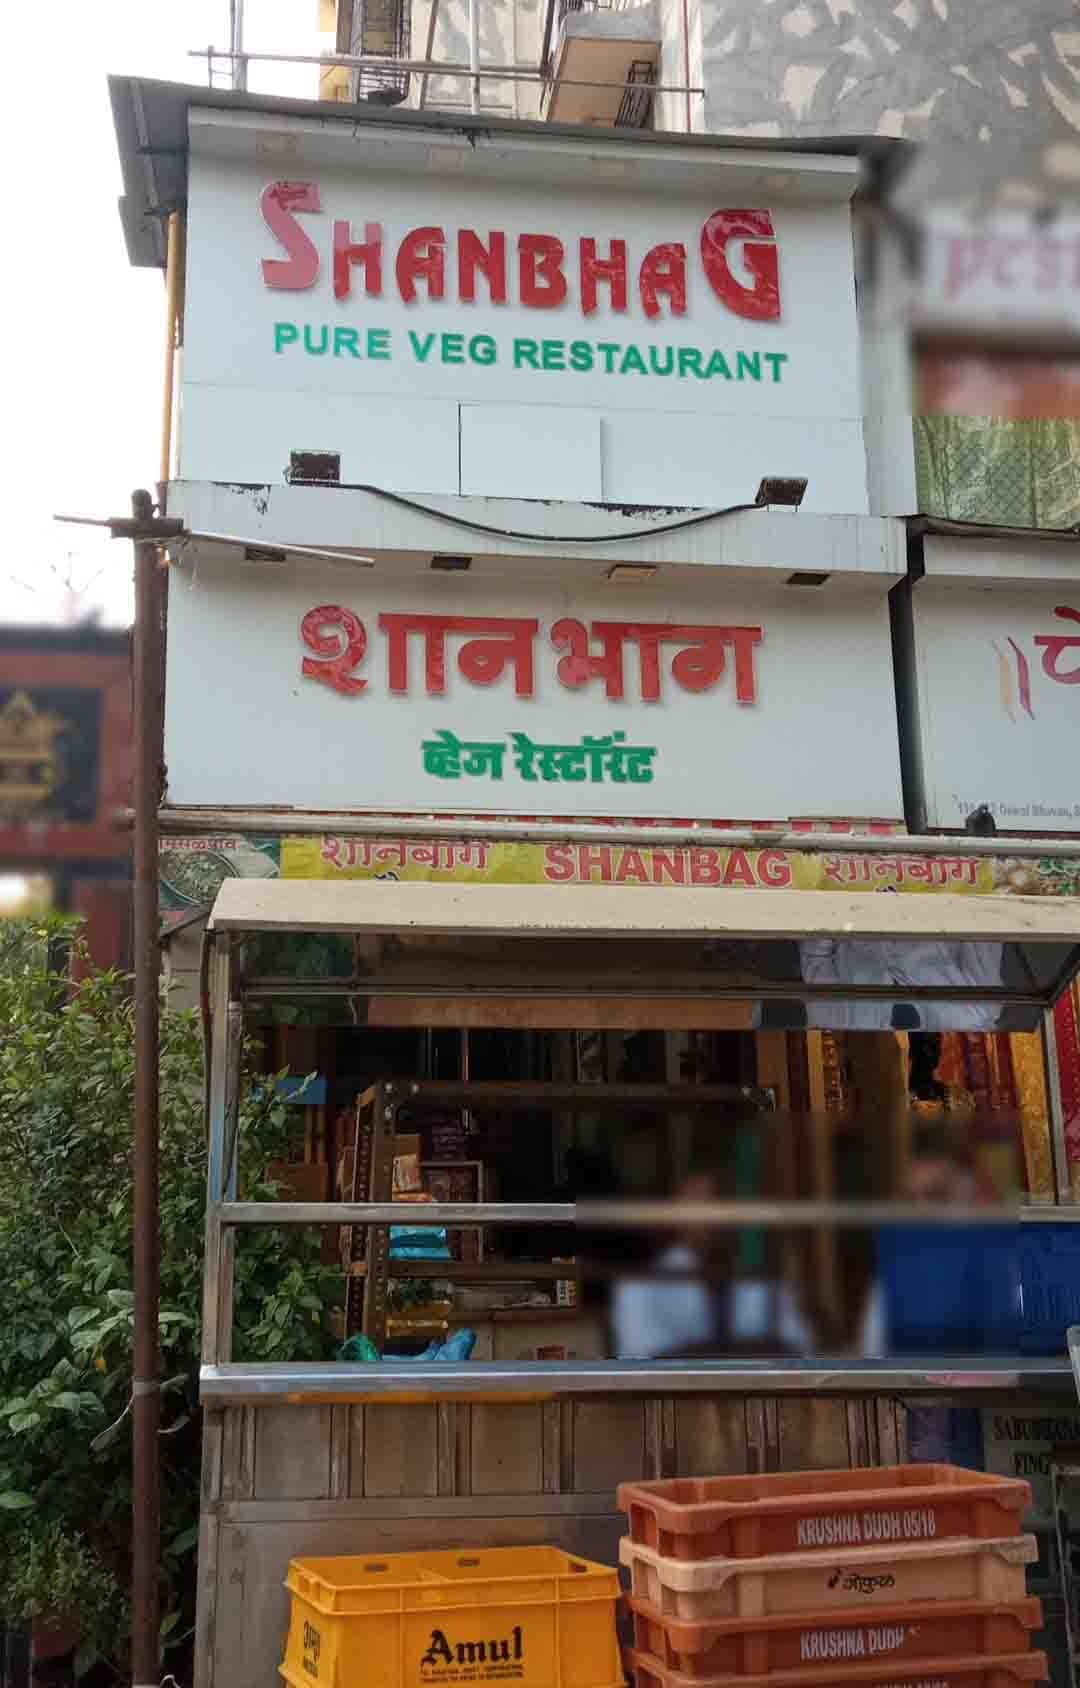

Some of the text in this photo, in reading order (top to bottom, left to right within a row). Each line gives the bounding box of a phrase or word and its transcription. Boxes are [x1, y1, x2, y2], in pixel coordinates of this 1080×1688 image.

[260, 181, 782, 322] SHANBHAG
[274, 322, 789, 383] PURE VEG RESTAURANT
[300, 604, 763, 706] शानभाग
[421, 729, 507, 780] व्हेज
[544, 844, 793, 888] SHANBAG
[798, 1511, 862, 1545] KRUSHNA
[863, 1510, 900, 1539] DUDH
[421, 1625, 523, 1666] Amul
[800, 1629, 865, 1660] KRUSHNA
